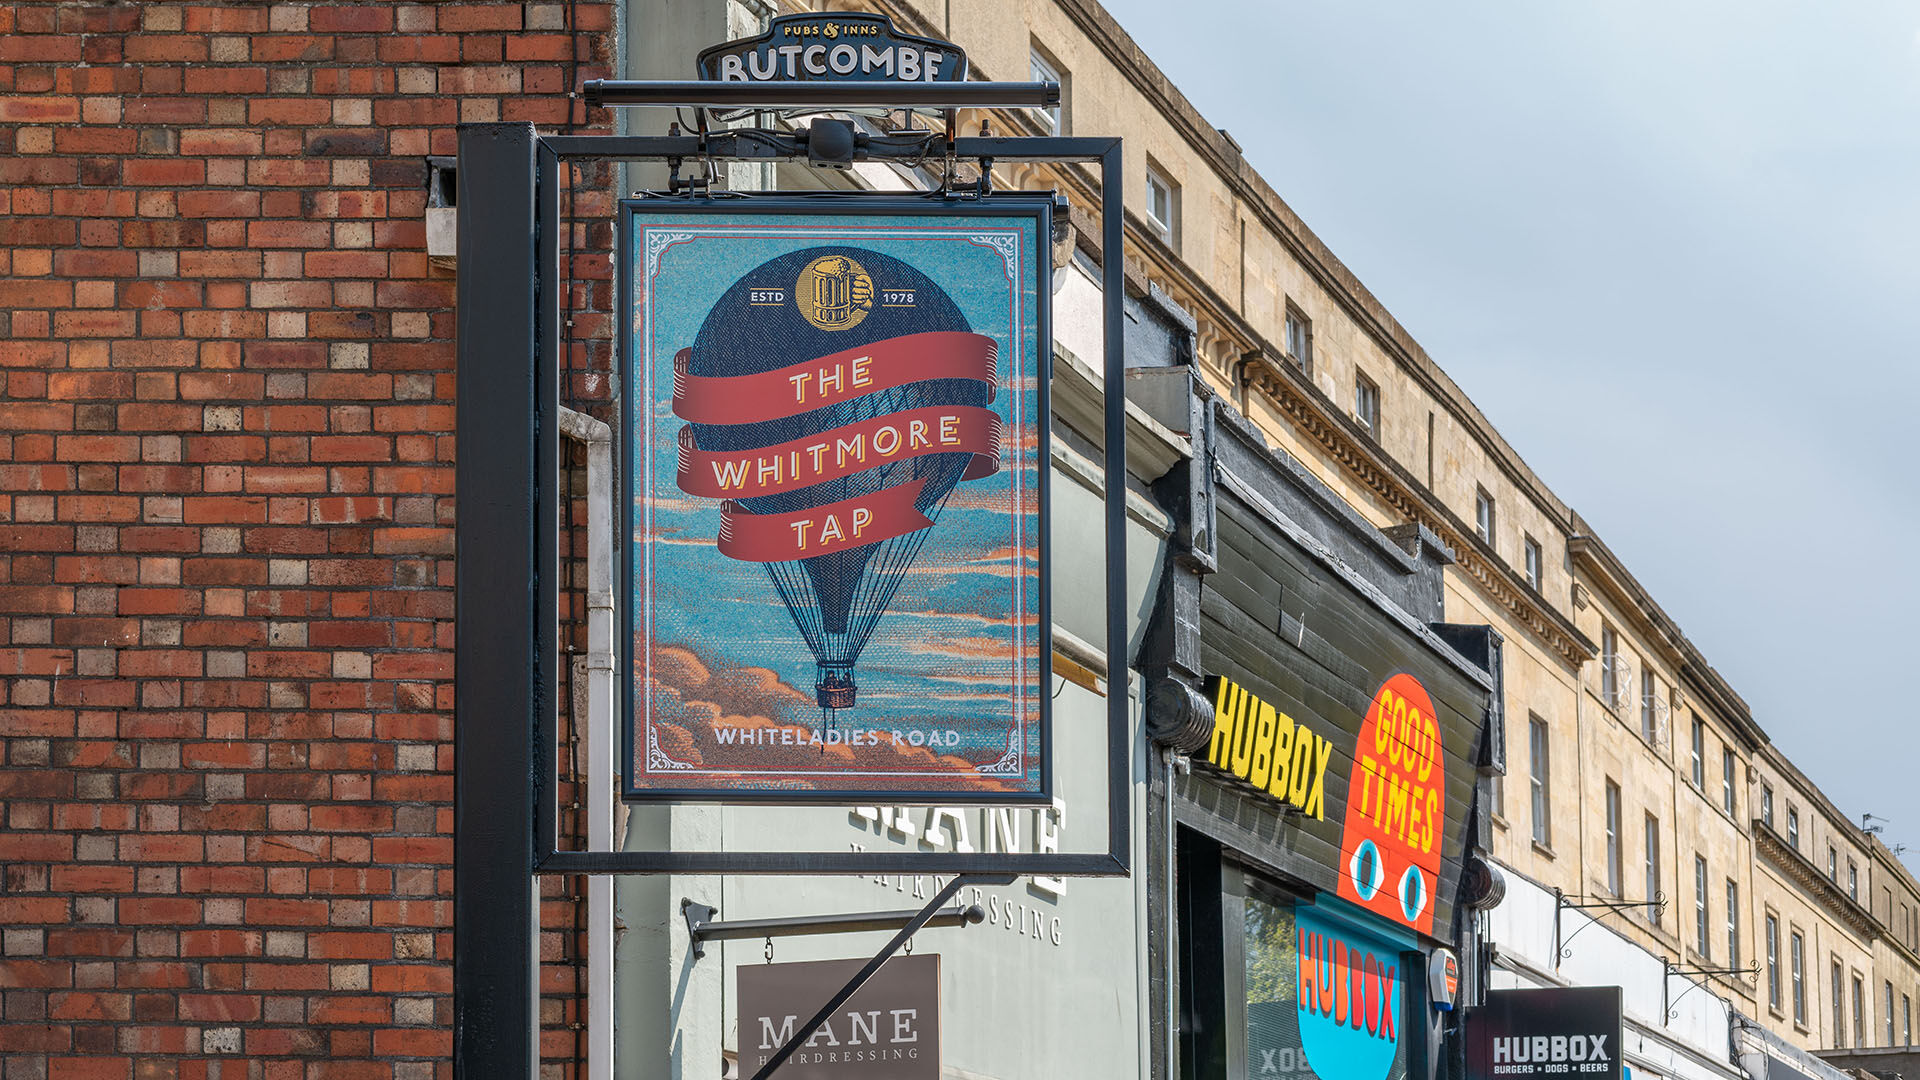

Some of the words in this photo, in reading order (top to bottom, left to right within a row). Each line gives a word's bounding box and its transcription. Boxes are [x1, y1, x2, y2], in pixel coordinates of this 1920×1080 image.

[784, 26, 819, 36] PUBS
[823, 22, 839, 38] &
[843, 26, 878, 36] INNS
[721, 44, 943, 83] BUTCOMBE
[751, 292, 784, 303] ESTD
[883, 293, 914, 304] 1978
[789, 355, 873, 404] THE
[711, 415, 962, 491] WHITMORE
[790, 507, 873, 551] TAP
[714, 728, 879, 747] WHITELADIES
[891, 730, 961, 747] ROAD
[1208, 675, 1333, 822] HUBBOX
[1375, 688, 1437, 783] GOOD
[1360, 754, 1439, 855] TIMES
[1298, 927, 1396, 1043] HUBBOX
[758, 1008, 918, 1050] MANE
[758, 1047, 918, 1066] HIRDRESSING
[1494, 1064, 1534, 1074] BURGERS
[1545, 1063, 1569, 1073] DOGS
[1580, 1063, 1609, 1073] BEERS
